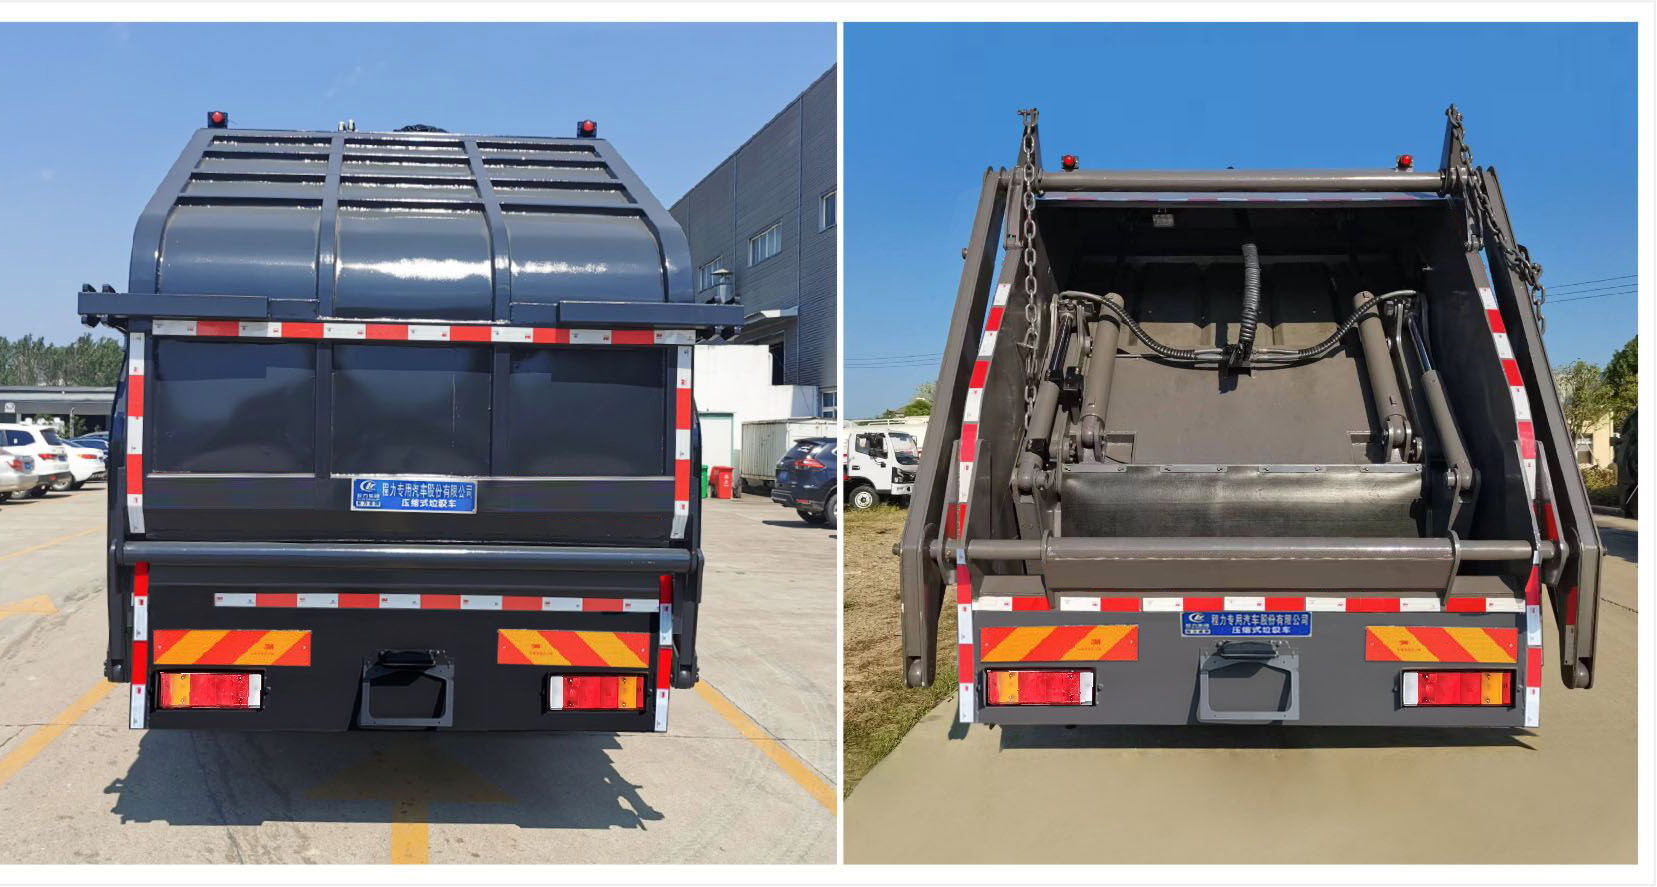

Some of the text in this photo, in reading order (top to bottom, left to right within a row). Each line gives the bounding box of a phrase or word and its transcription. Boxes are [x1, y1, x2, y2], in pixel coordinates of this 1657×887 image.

[382, 482, 473, 498] 程力专用汽车股份有限公司
